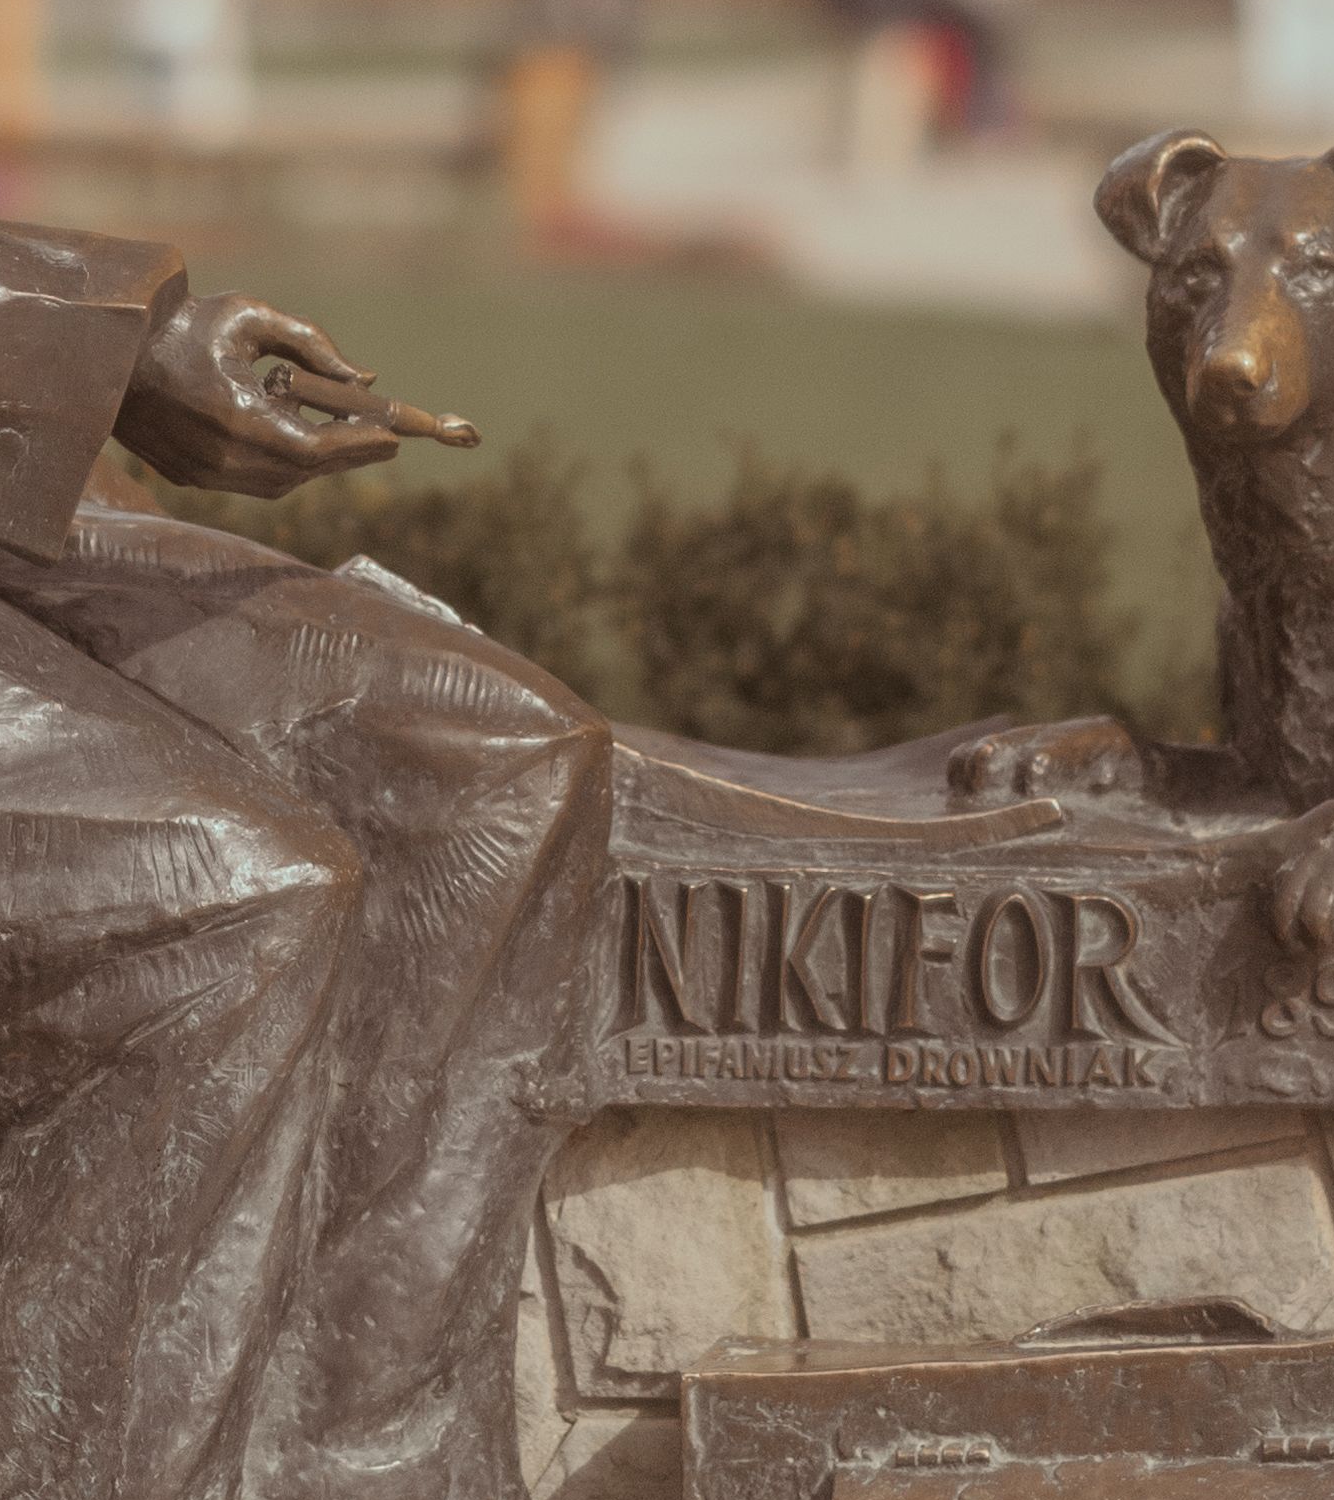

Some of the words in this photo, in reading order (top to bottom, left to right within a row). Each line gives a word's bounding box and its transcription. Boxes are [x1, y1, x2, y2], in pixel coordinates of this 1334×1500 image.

[612, 872, 1192, 1050] NIKIFOR
[624, 1037, 859, 1083] EPIFANIUSZ
[881, 1045, 1157, 1088] DROWNIAK
